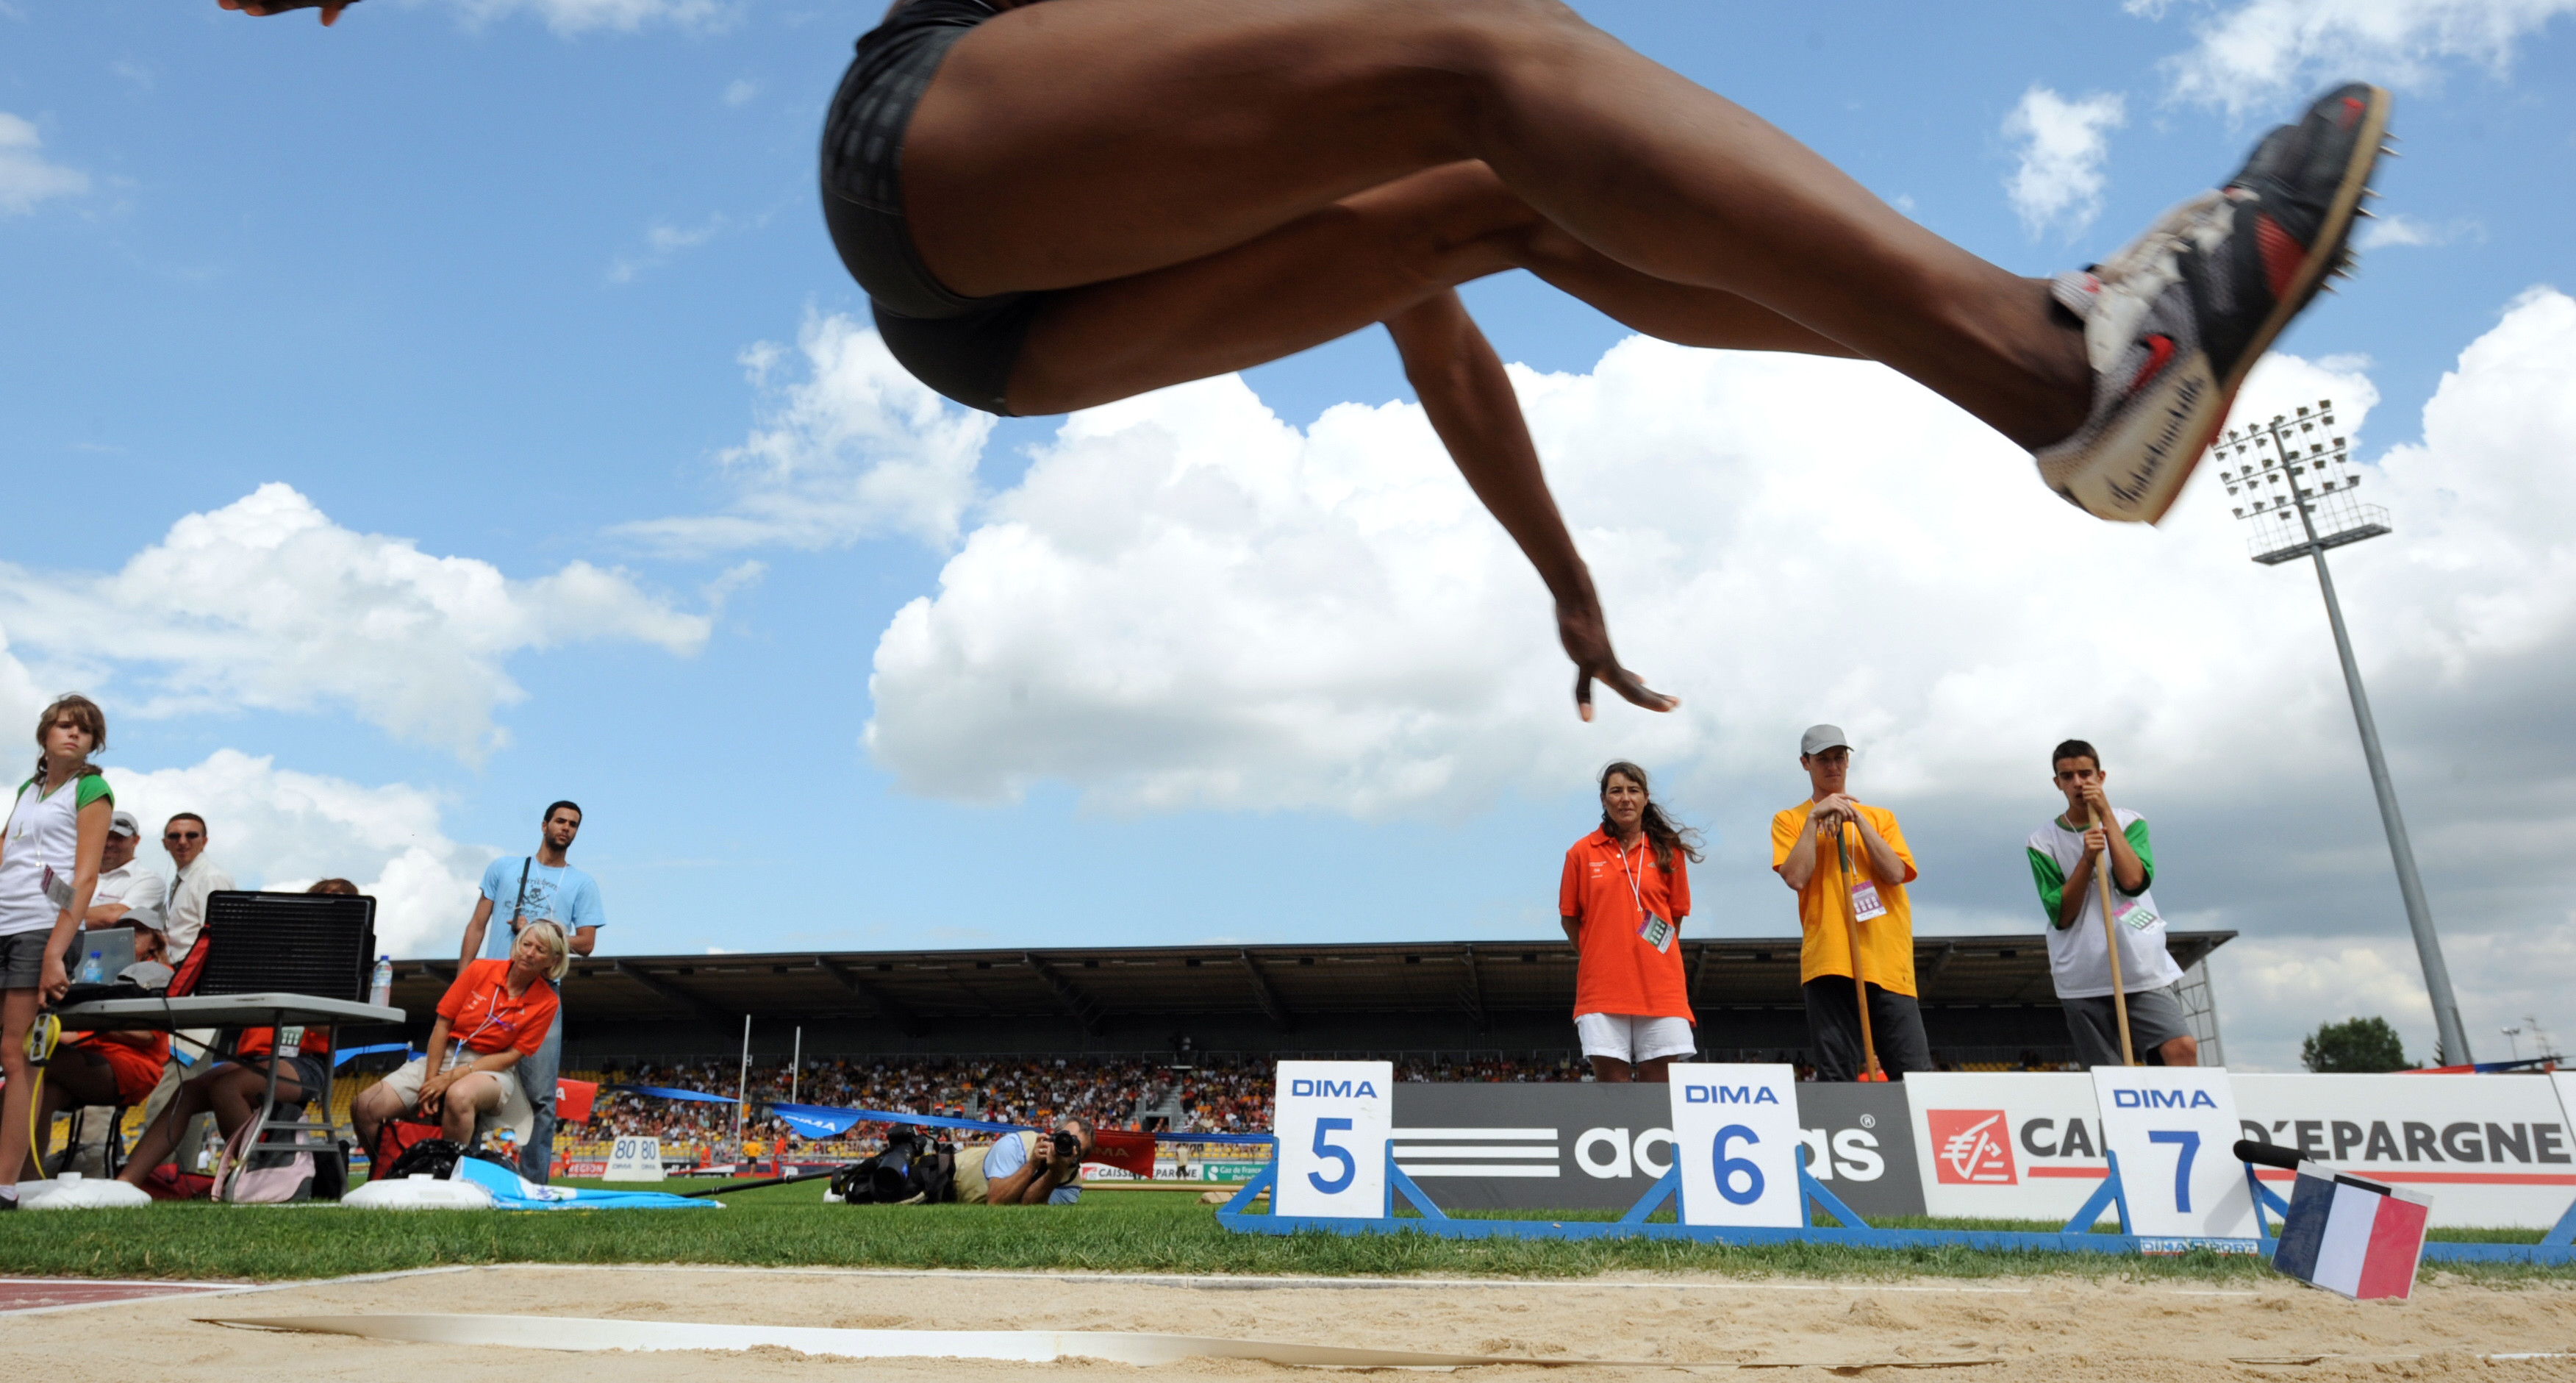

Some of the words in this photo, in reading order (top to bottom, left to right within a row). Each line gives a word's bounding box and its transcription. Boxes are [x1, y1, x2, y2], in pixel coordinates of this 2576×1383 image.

[1292, 1079, 1378, 1098] DIMA
[1685, 1085, 1779, 1104] DIMA
[2114, 1090, 2218, 1109] DIMA
[615, 1140, 636, 1159] 80
[642, 1140, 656, 1159] 80
[1308, 1118, 1356, 1194] 5
[1712, 1124, 1765, 1205] 6
[2148, 1131, 2200, 1212] 7
